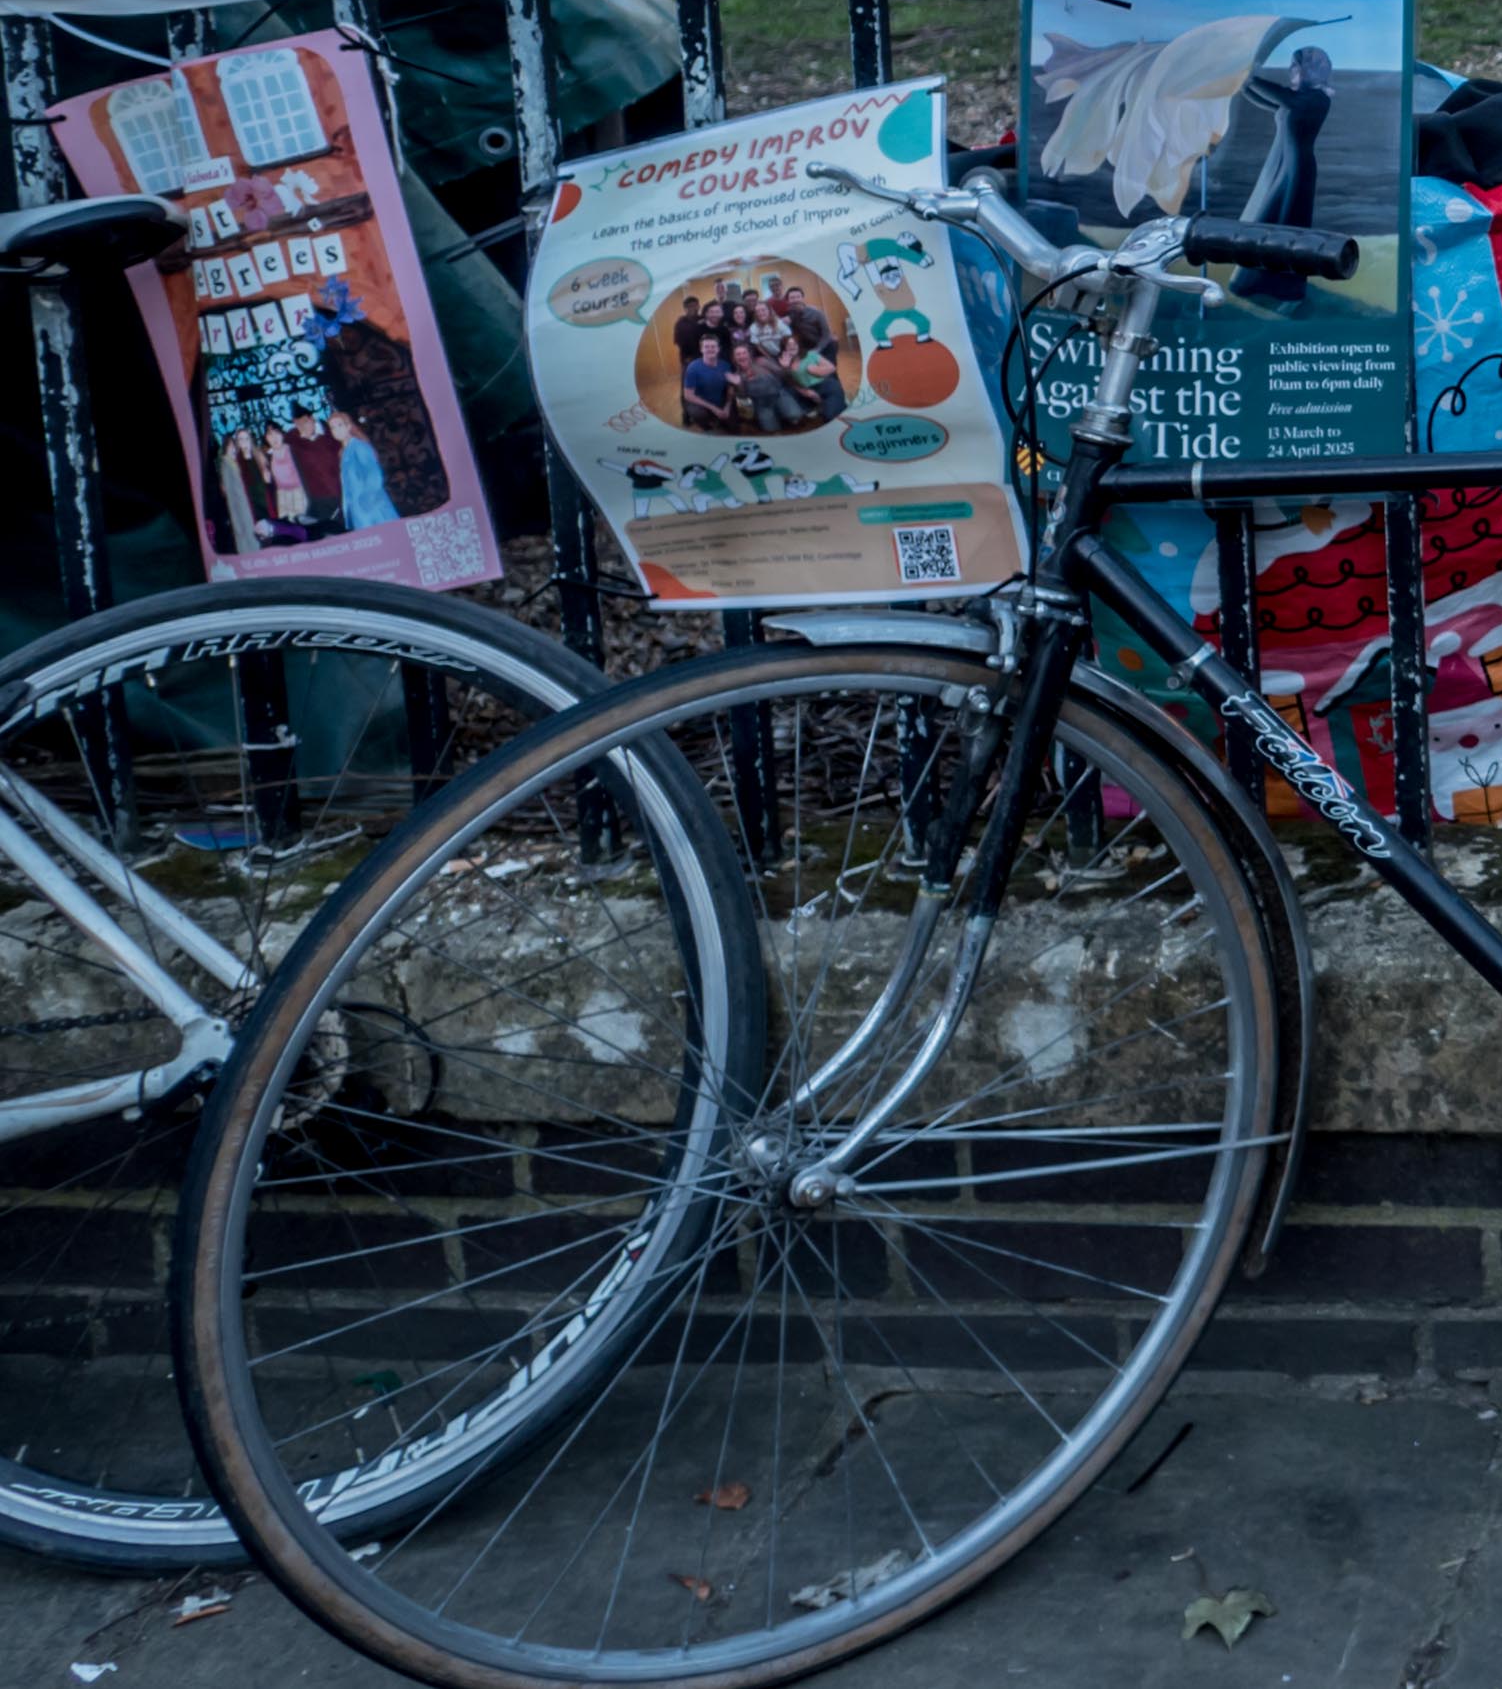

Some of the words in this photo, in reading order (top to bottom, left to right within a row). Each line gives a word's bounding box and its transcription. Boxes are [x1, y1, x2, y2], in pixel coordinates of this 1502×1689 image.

[617, 143, 738, 188] COMEDY
[749, 117, 870, 159] IMPROV
[677, 157, 798, 200] COURSE
[1269, 343, 1338, 355] Exhibition
[1341, 344, 1373, 356] open
[1376, 344, 1390, 353] to
[1175, 381, 1241, 416] the
[1269, 401, 1294, 415] Free
[1297, 402, 1352, 414] admission
[852, 432, 940, 455] beginners
[874, 422, 903, 436] For
[1142, 421, 1240, 459] Tide
